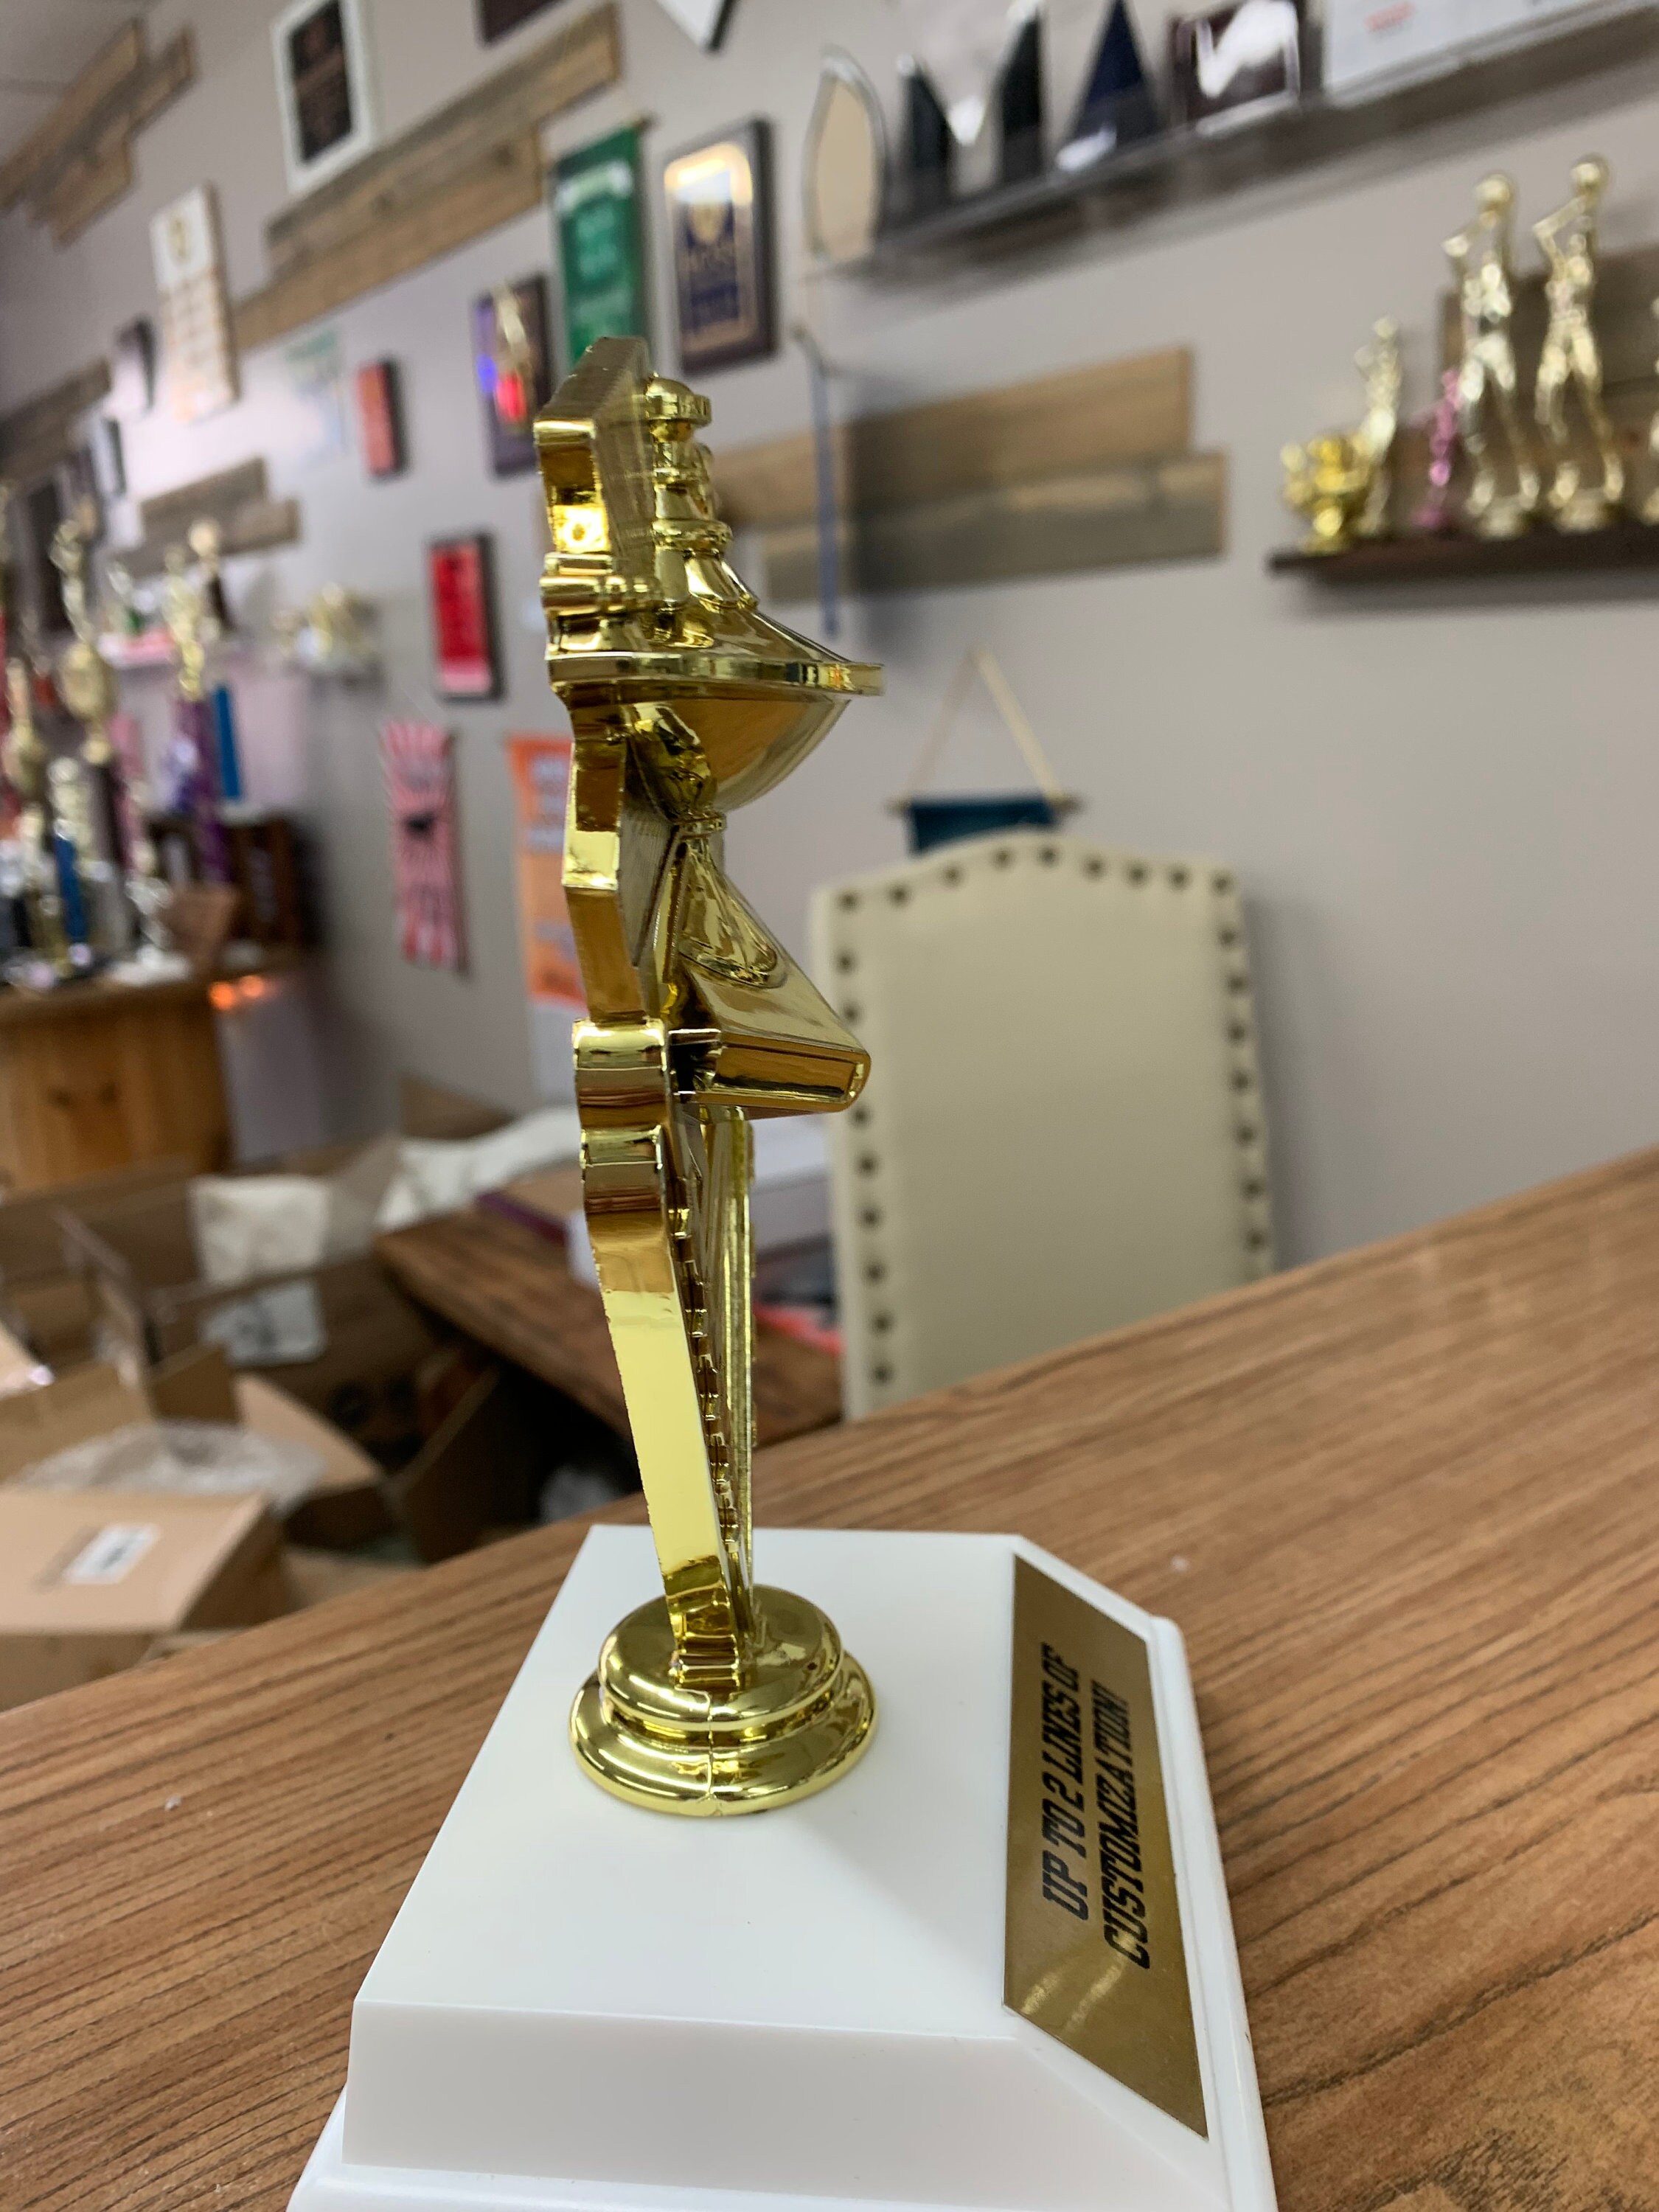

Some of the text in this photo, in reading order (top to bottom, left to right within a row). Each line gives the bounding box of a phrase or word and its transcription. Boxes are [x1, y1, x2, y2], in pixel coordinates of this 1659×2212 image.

[1041, 1642, 1089, 1921] UP TO 2 LINES OF
[1091, 1680, 1151, 1970] CUSTOMIZATION
